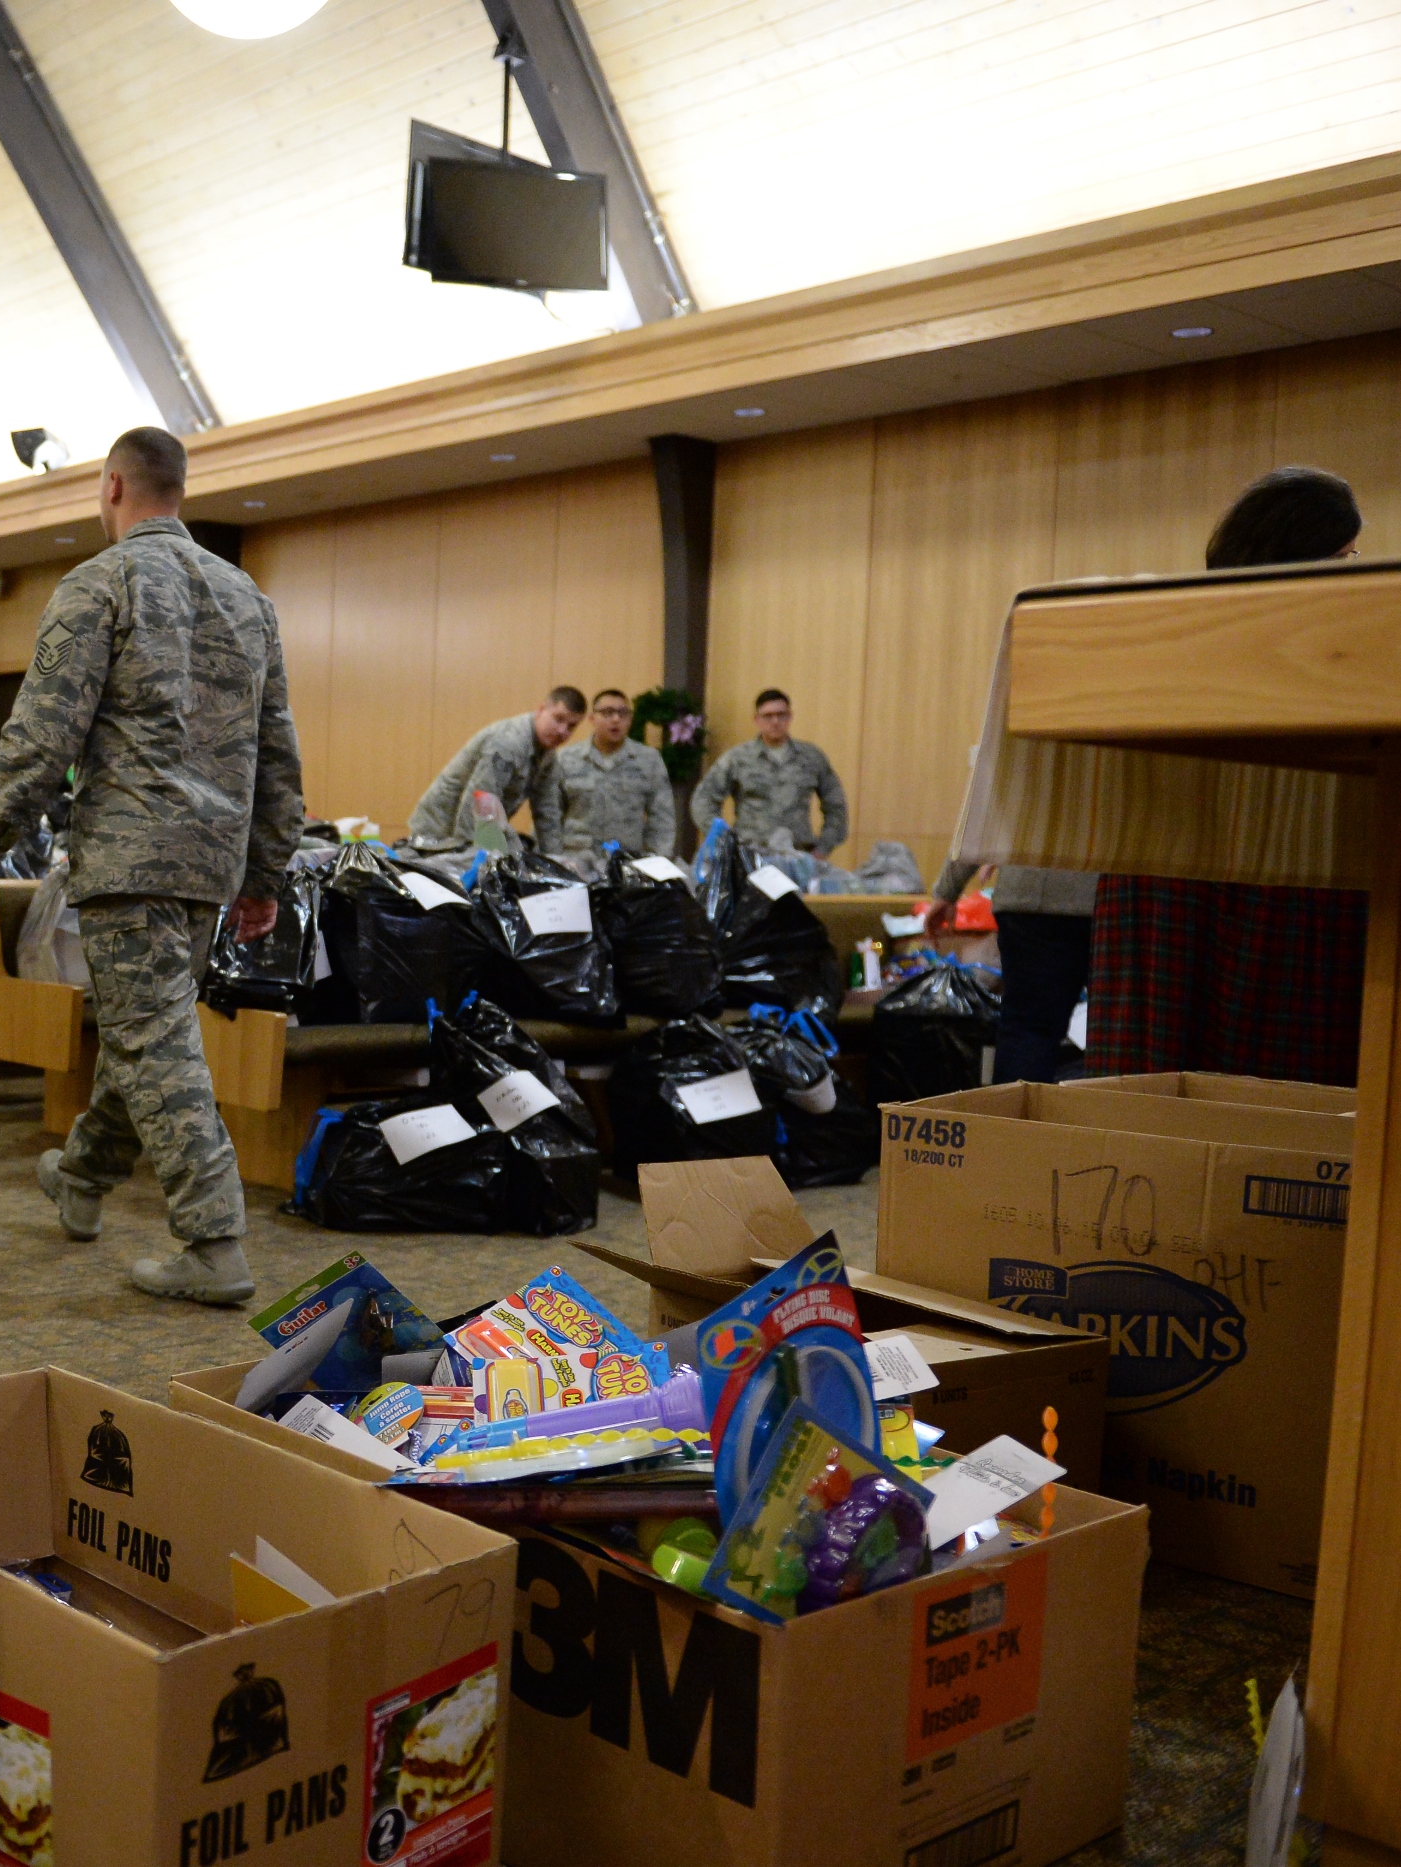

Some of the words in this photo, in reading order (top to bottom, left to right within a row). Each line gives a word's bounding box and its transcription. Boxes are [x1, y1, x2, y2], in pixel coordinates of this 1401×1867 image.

[886, 1112, 967, 1149] 07458
[904, 1148, 945, 1166] 18/200
[948, 1154, 965, 1168] CT
[1051, 1164, 1156, 1257] 170
[1003, 1275, 1055, 1291] STORE
[1015, 1266, 1055, 1281] HOME
[277, 1300, 329, 1336] Guitar
[531, 1296, 592, 1347] TUNES
[553, 1290, 592, 1325] TOY
[771, 1290, 808, 1325] FLYING
[808, 1288, 831, 1304] DISC
[781, 1305, 819, 1335] DISQUE
[819, 1303, 856, 1327] VOLANT
[530, 1332, 560, 1357] HARM
[595, 1361, 625, 1400] TUN
[621, 1364, 652, 1393] TO
[369, 1401, 389, 1419] Jump
[389, 1388, 411, 1404] Rope
[380, 1401, 405, 1420] Corde
[385, 1404, 412, 1424] sauter
[1148, 1456, 1257, 1508] Napkin
[67, 1497, 107, 1553] FOIL
[116, 1520, 172, 1583] PANS
[931, 1589, 1002, 1638] Scotch
[510, 1536, 762, 1809] 3M
[925, 1652, 971, 1689] Tape
[975, 1624, 1022, 1670] 2-PK
[921, 1693, 982, 1740] Inside
[180, 1802, 250, 1867] FOIL
[266, 1763, 348, 1845] PANS
[378, 1813, 396, 1847] 2
